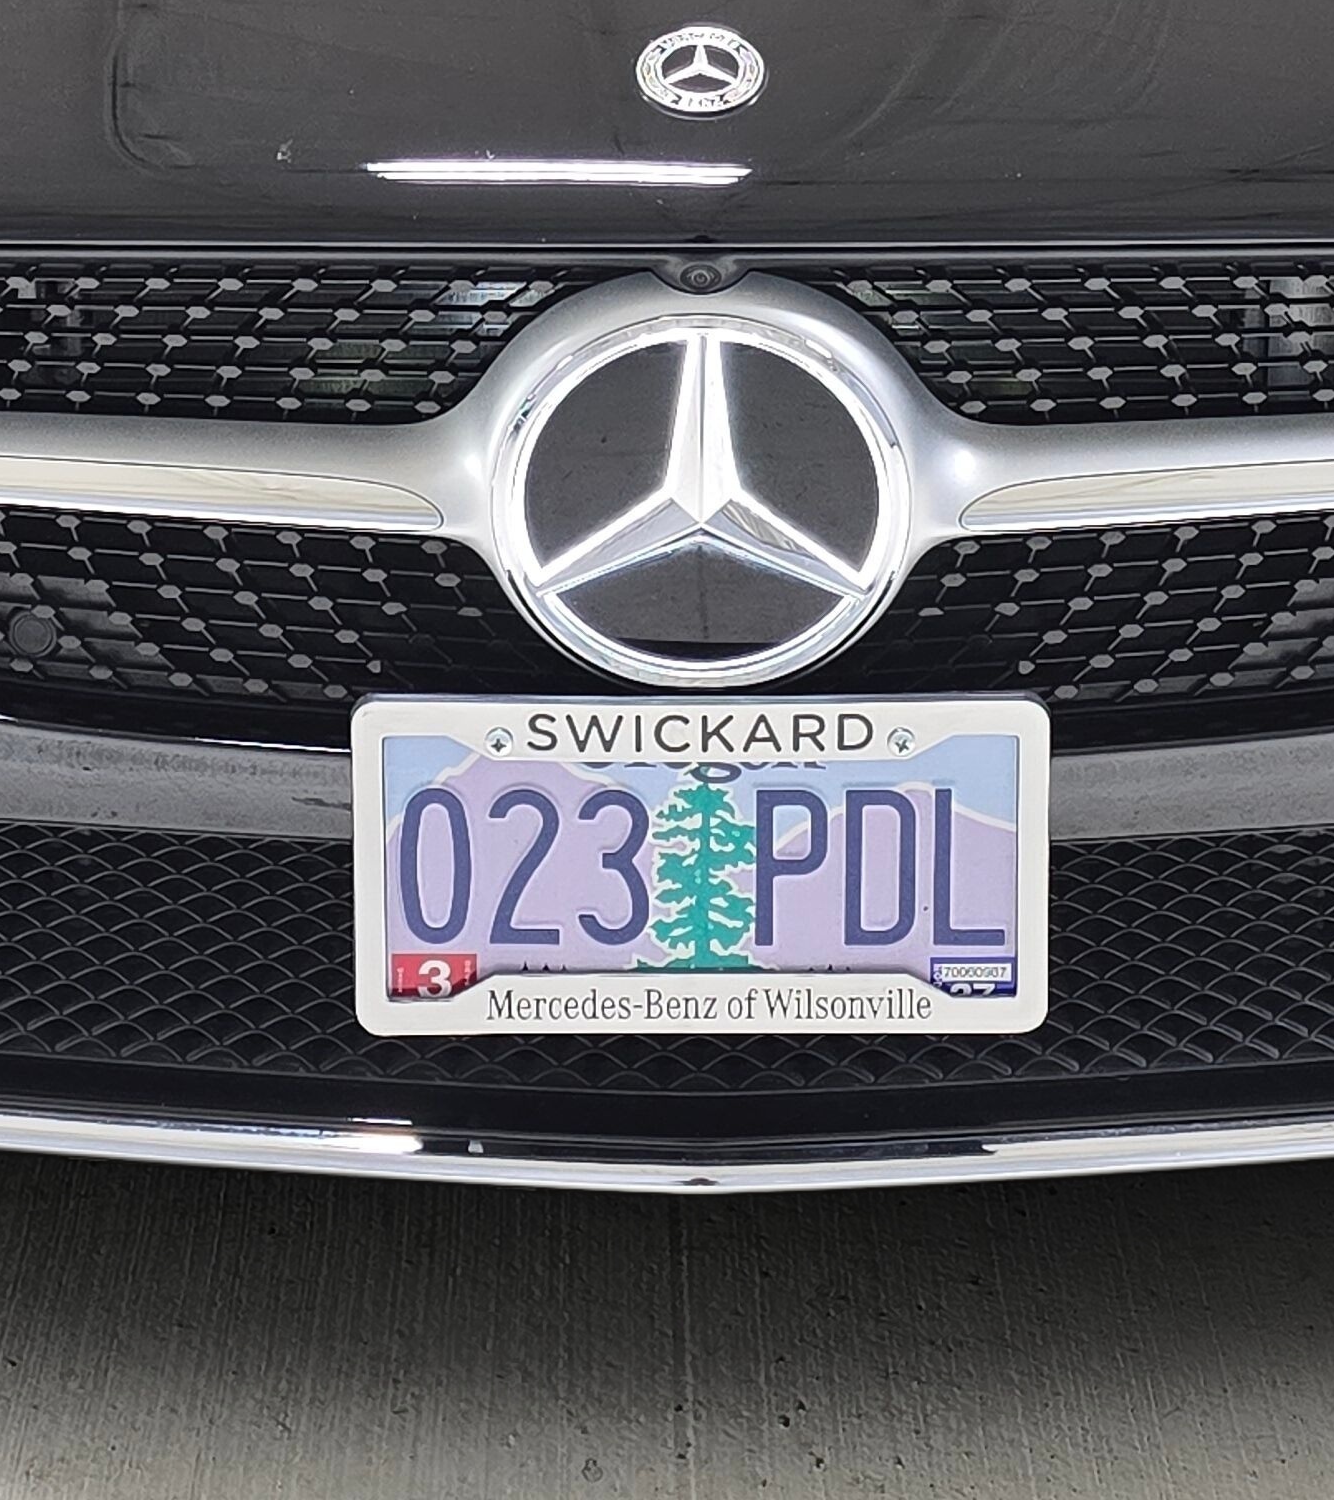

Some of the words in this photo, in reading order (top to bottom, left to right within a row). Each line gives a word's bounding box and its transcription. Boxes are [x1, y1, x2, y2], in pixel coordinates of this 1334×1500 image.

[527, 713, 874, 752] SWICKARD
[399, 787, 650, 946] 023
[754, 788, 1006, 946] PDL
[417, 959, 453, 998] 3
[486, 989, 717, 1021] Mercedes-Benz
[727, 989, 758, 1021] of
[764, 988, 933, 1021] Wilsonville
